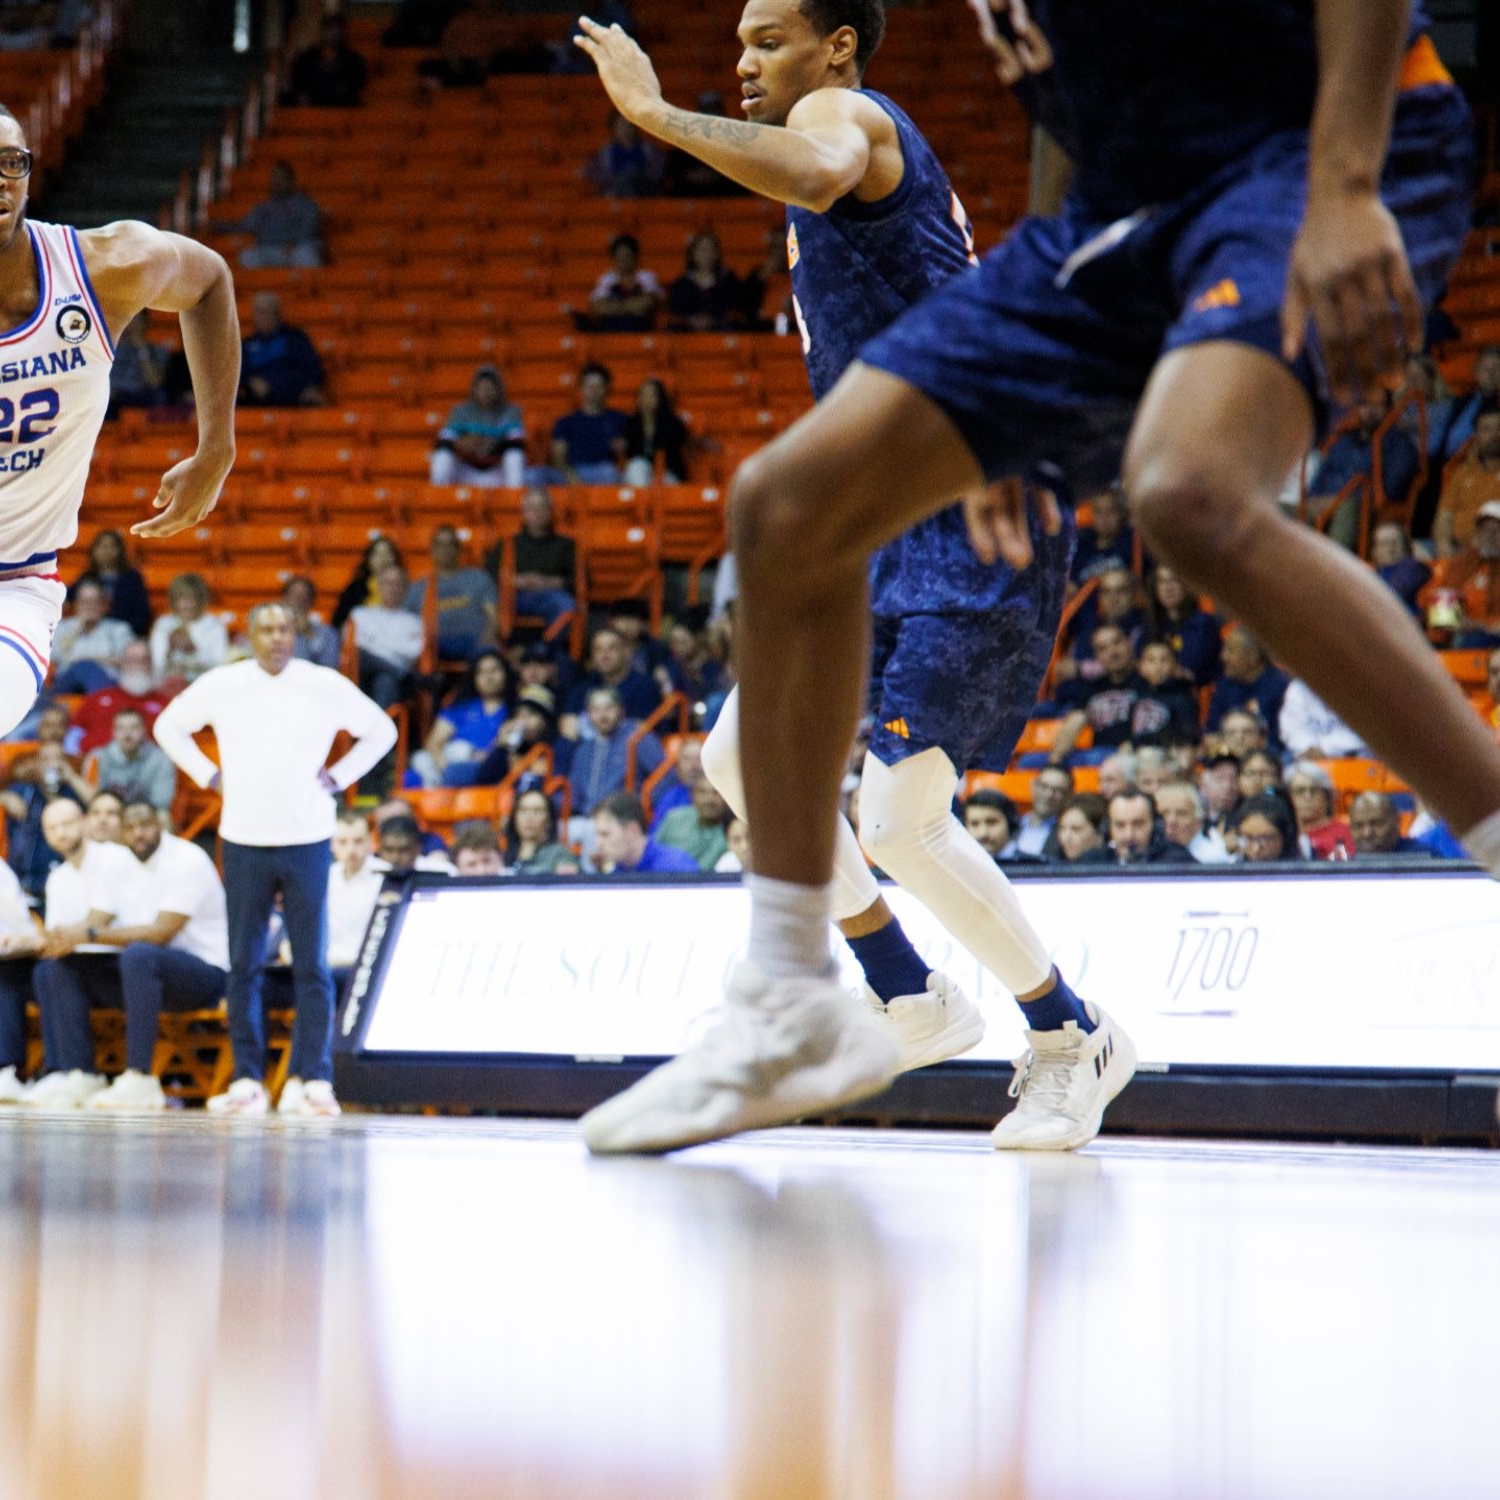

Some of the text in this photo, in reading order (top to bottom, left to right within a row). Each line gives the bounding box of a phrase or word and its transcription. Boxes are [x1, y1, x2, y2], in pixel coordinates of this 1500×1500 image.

[427, 938, 541, 997] THE
[548, 938, 702, 998] SOUL
[1165, 926, 1260, 1002] 1700
